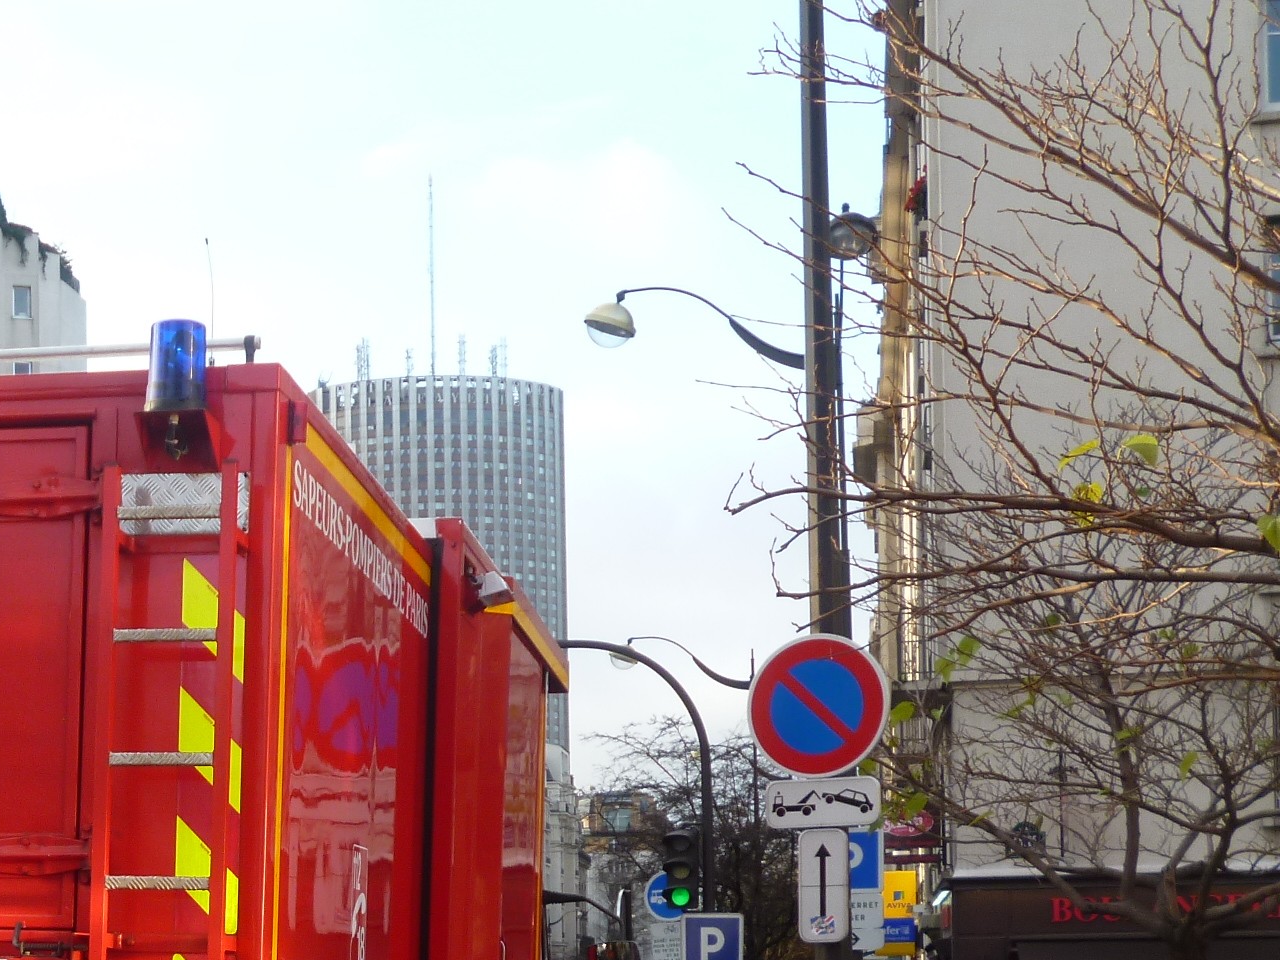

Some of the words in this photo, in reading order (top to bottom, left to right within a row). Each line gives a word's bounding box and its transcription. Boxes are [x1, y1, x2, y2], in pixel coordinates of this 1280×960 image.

[293, 459, 393, 601] SAPEURS-POMPIERS
[393, 567, 406, 615] DE
[406, 581, 429, 638] PARIS
[851, 901, 879, 909] ERRET
